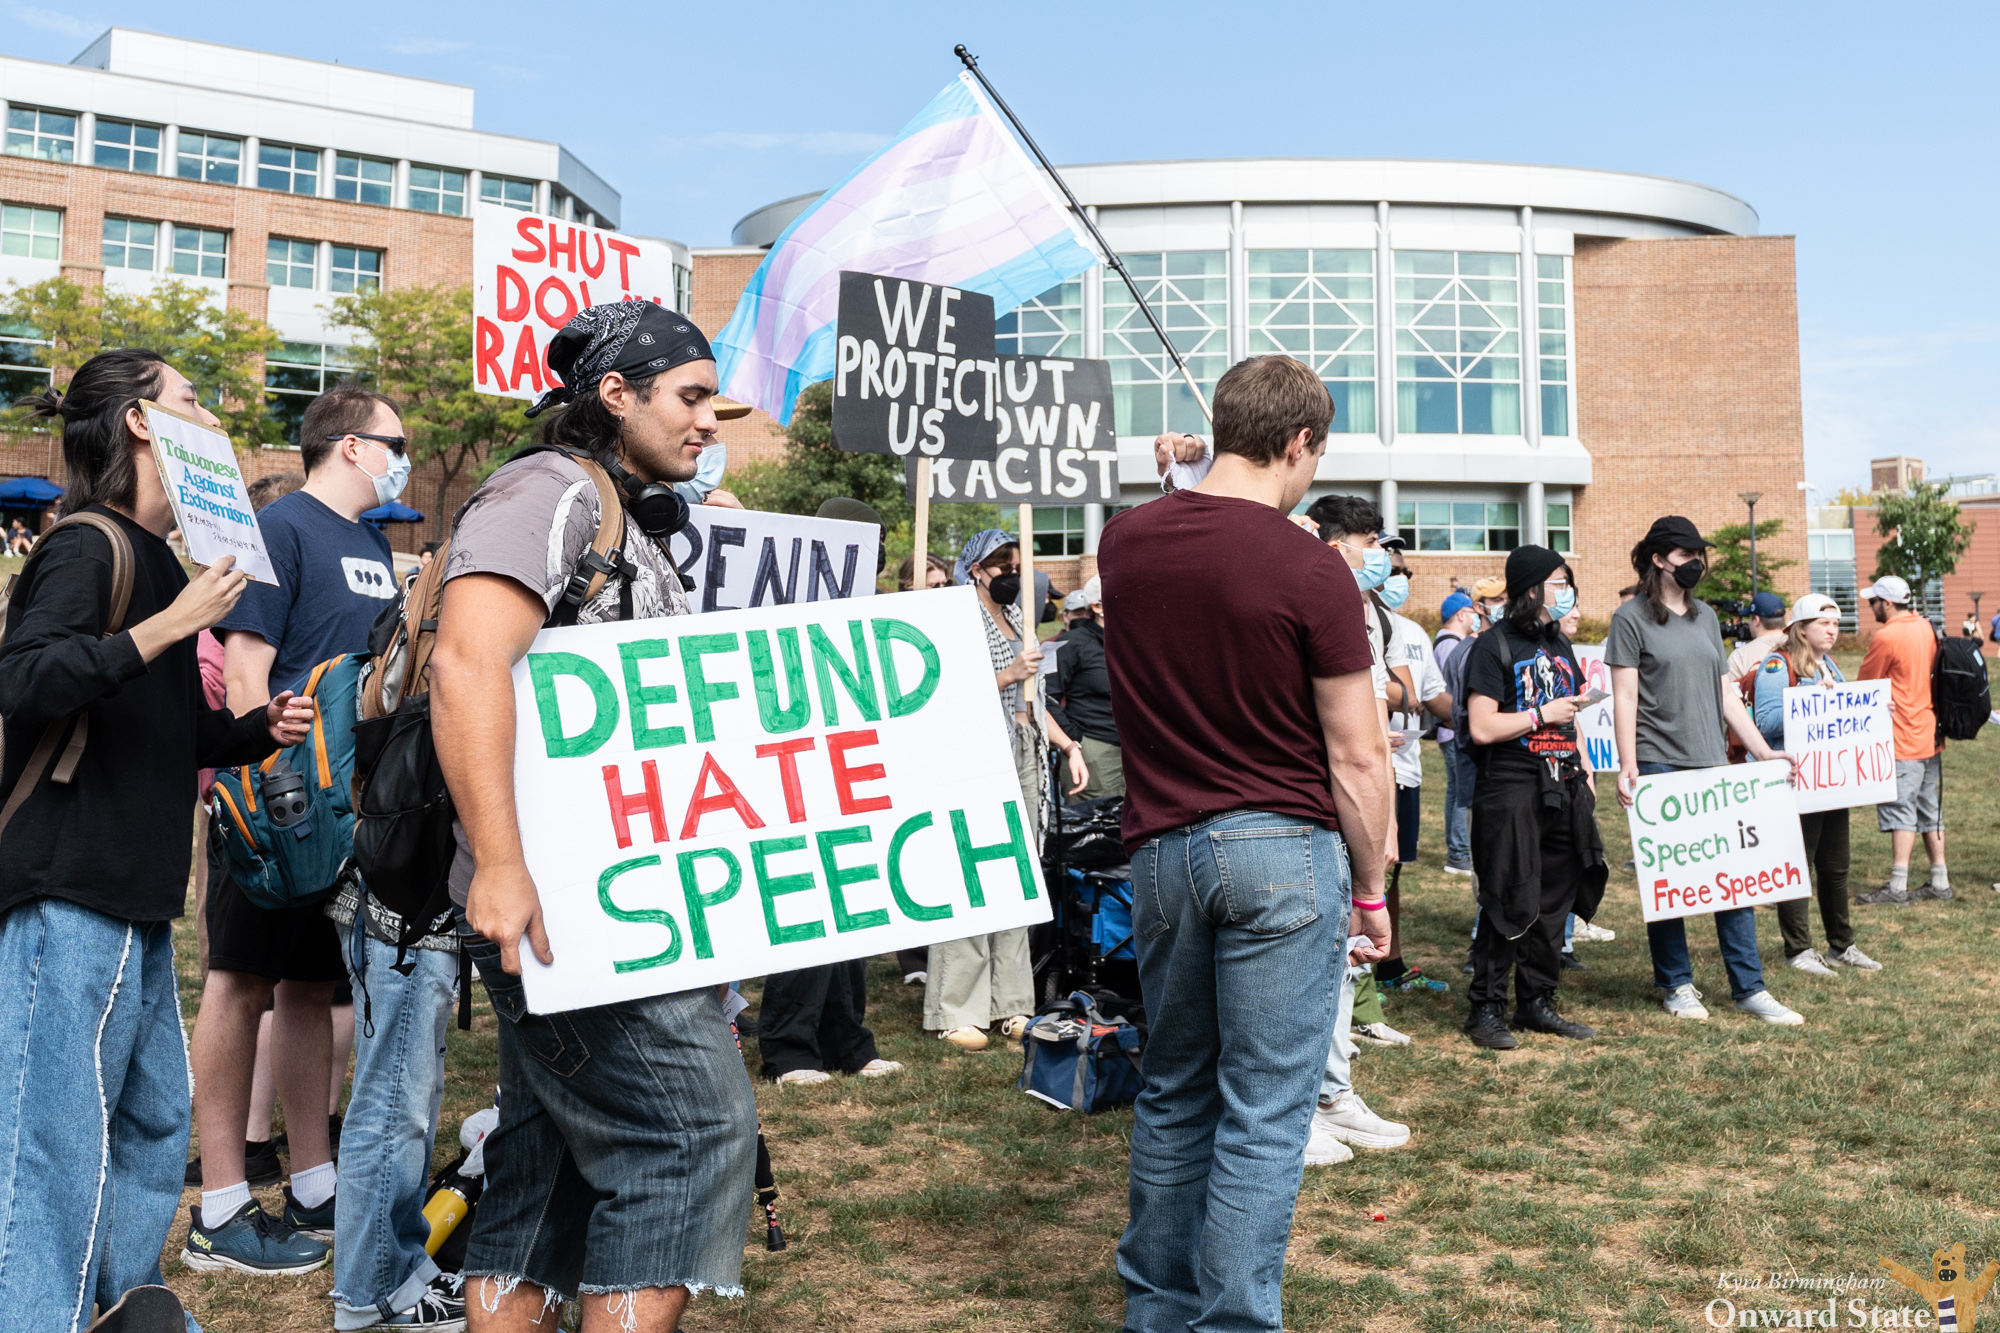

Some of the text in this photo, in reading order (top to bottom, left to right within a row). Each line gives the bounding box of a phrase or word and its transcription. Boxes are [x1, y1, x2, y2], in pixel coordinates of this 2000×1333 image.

[512, 217, 640, 291] SHUT
[874, 279, 961, 354] WE
[476, 316, 565, 392] RAC
[837, 335, 996, 421] PROTECT
[995, 357, 1074, 404] UT
[888, 402, 945, 455] US
[160, 436, 239, 481] Taiwanese
[184, 465, 237, 500] Against
[177, 485, 254, 527] Extremism
[528, 617, 941, 758] DEFUND
[1791, 689, 1880, 720] ANTI-TRANS
[1807, 715, 1872, 744] RHETORIC
[602, 729, 892, 849] HATE
[1796, 740, 1893, 791] KILLS KIDS
[1638, 820, 1759, 872] Speech is
[597, 800, 1038, 975] SPEECH
[1654, 862, 1801, 911] Free Speech
[190, 1230, 213, 1251] HOKA
